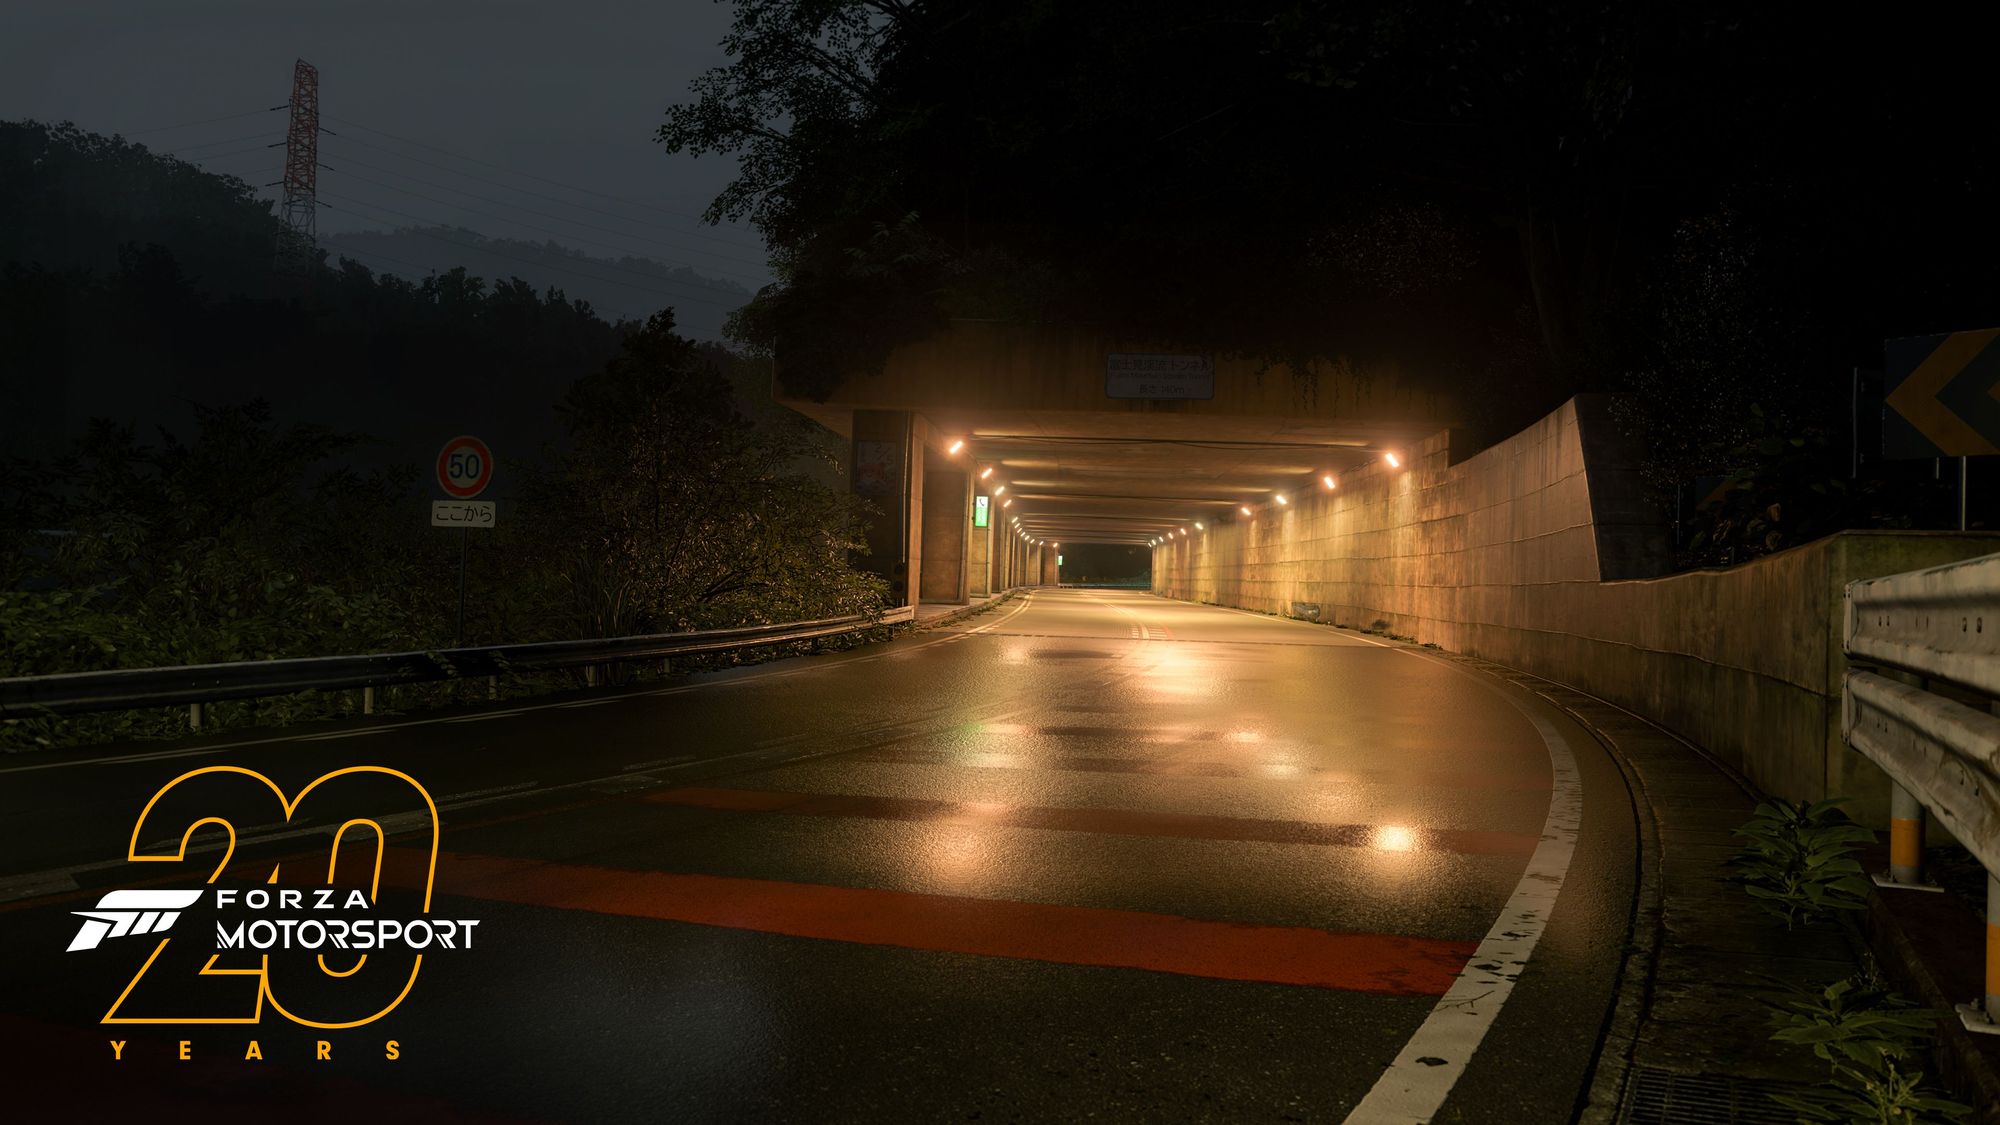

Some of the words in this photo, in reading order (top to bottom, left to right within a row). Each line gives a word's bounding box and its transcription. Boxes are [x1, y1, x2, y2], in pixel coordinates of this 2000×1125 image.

[449, 454, 480, 479] 50
[436, 505, 493, 523] ここから
